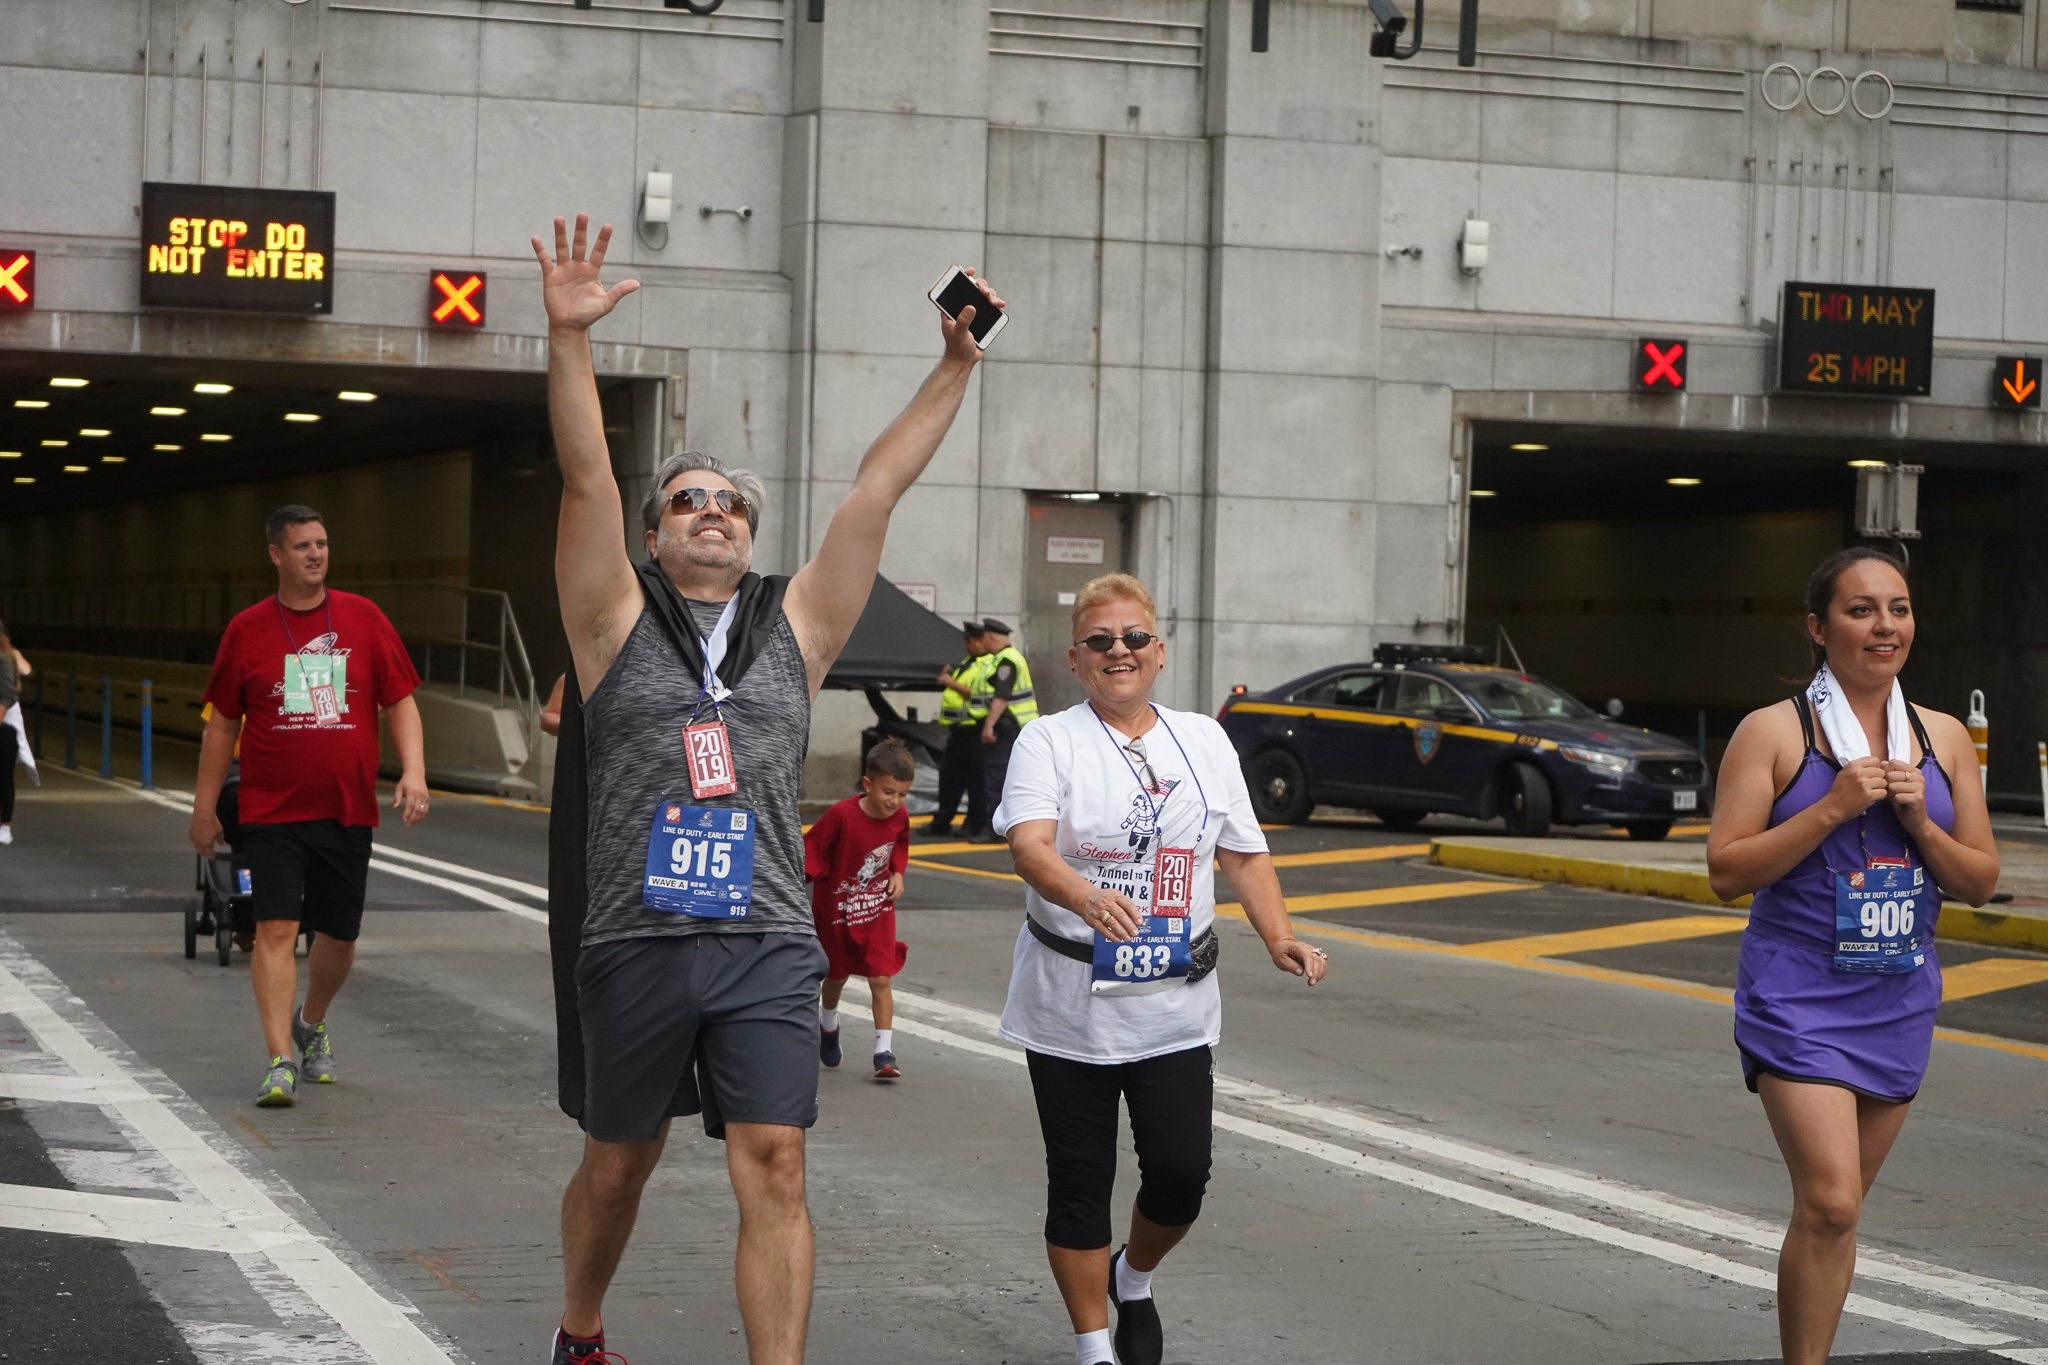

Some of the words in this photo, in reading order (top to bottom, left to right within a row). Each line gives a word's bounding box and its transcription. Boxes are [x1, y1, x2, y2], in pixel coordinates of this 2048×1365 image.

[169, 217, 248, 248] STOP
[266, 222, 305, 251] DO
[148, 244, 206, 275] NOT
[226, 248, 324, 280] ENTER
[1798, 291, 1852, 322] TWO
[1862, 294, 1924, 326] WAY
[1807, 352, 1842, 383] 25
[1852, 355, 1907, 386] MPH
[298, 670, 331, 691] 111
[316, 689, 331, 703] 20
[319, 702, 334, 717] 19
[694, 731, 721, 758] 20
[698, 755, 725, 781] 19
[662, 826, 677, 835] LINE
[685, 829, 703, 838] DUTY
[708, 831, 726, 840] EARLY
[727, 833, 745, 841] START
[670, 837, 732, 879] 915
[1075, 842, 1134, 863] Stephen
[1135, 872, 1143, 880] TO
[1163, 855, 1186, 878] 20
[651, 877, 677, 888] WAVE
[680, 881, 685, 889] A
[694, 889, 716, 897] GMC
[1139, 885, 1149, 900] &
[1162, 879, 1184, 901] 19
[1848, 892, 1863, 900] LINE
[1872, 891, 1888, 899] DUTY
[1893, 890, 1910, 898] EARLY
[730, 905, 747, 917] 915
[1861, 899, 1915, 938] 906
[1842, 943, 1868, 951] WAVE
[1114, 945, 1171, 978] 833
